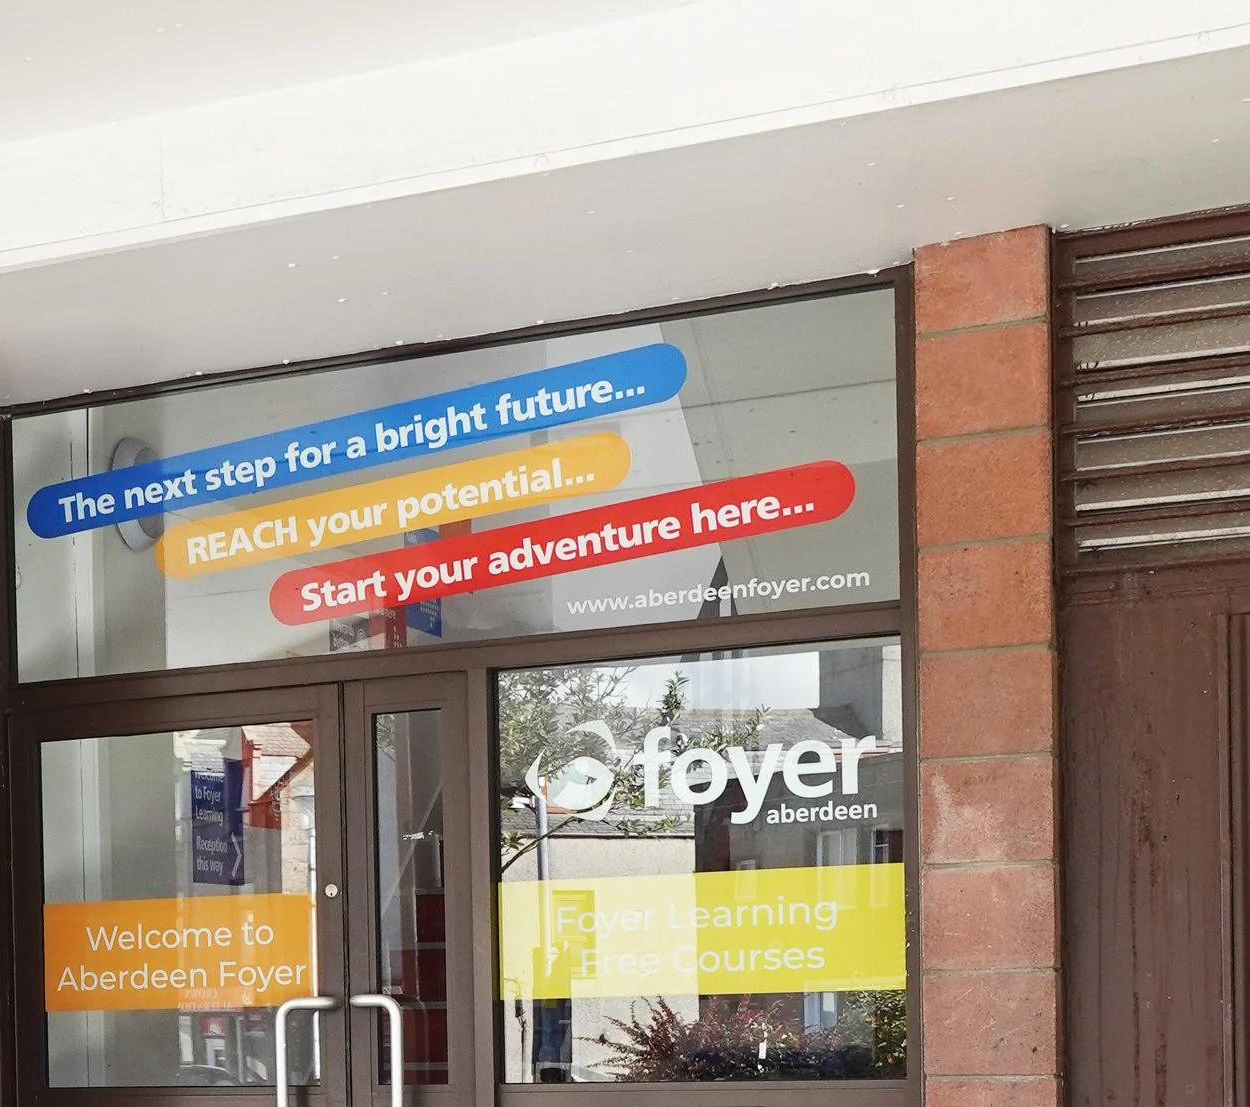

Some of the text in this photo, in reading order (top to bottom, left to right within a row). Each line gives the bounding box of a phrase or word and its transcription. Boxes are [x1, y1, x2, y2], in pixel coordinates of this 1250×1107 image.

[58, 376, 646, 524] The next step for a bright future...
[187, 456, 596, 566] REACH your potential...
[301, 495, 815, 612] Start your adventure here...
[566, 569, 870, 616] www.aberdeenfoyer.com
[633, 726, 876, 825] foyer
[203, 786, 221, 804] Foyer
[196, 806, 223, 825] Learning
[766, 800, 878, 824] aberdeen
[196, 836, 227, 855] Reception
[196, 858, 224, 876] this way
[556, 896, 838, 939] Foyer Learning
[86, 921, 275, 952] Welcome to
[581, 945, 826, 976] Free Courses
[57, 961, 307, 993] Aberdeen Foyer
